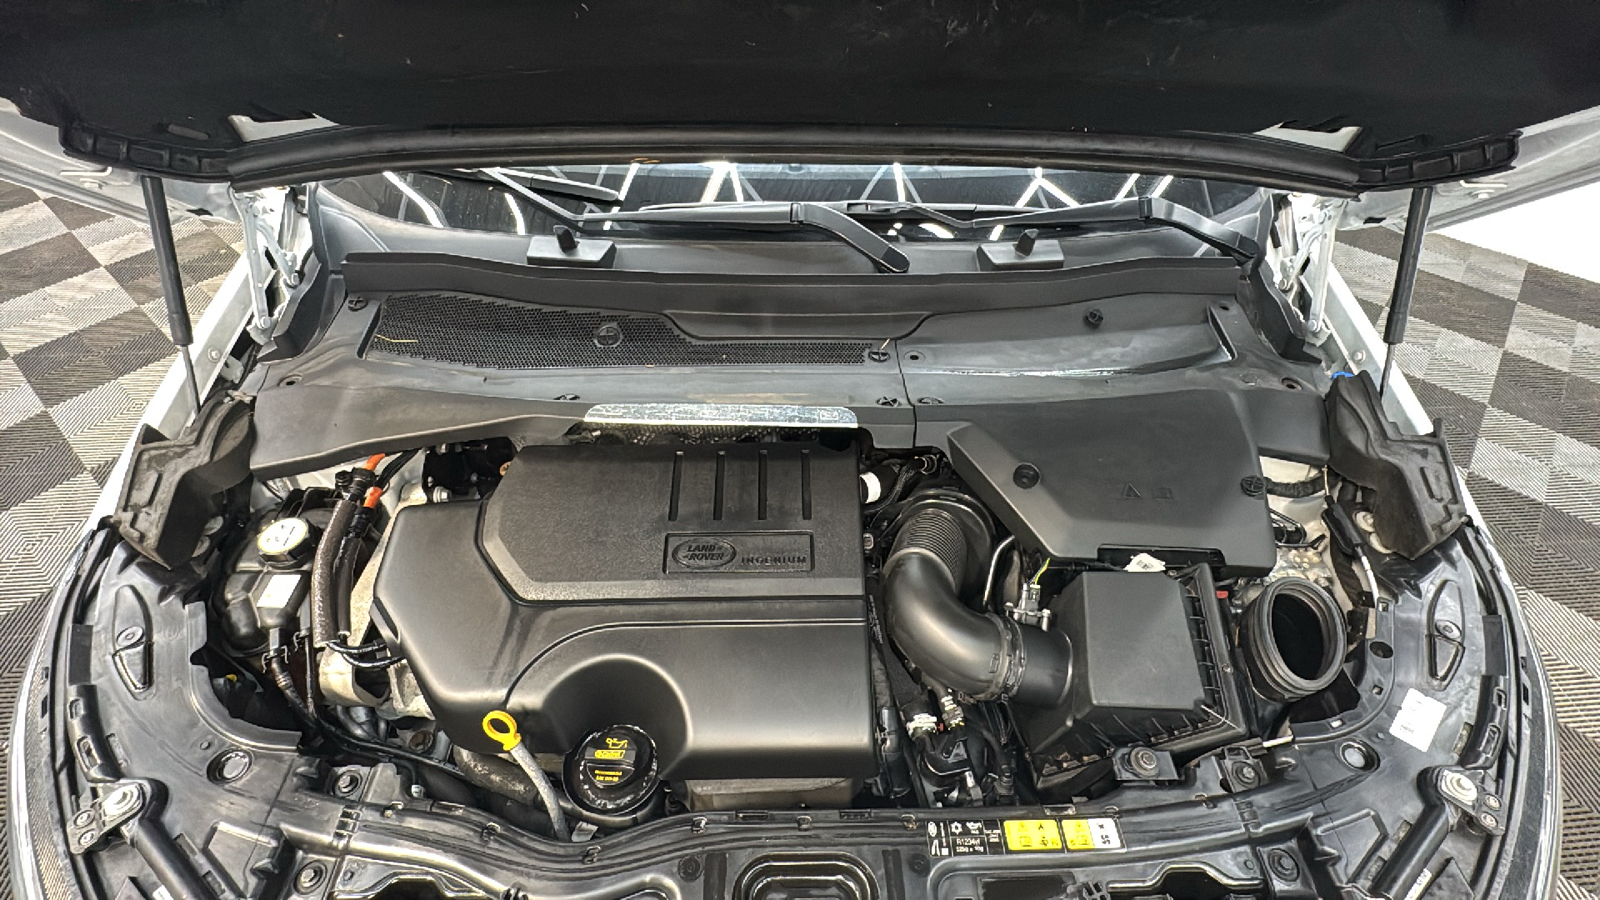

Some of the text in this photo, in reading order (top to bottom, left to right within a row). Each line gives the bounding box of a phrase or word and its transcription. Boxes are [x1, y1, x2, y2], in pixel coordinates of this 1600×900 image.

[687, 544, 716, 552] LAND
[688, 552, 725, 560] ROVER
[741, 555, 807, 565] INGENIUM
